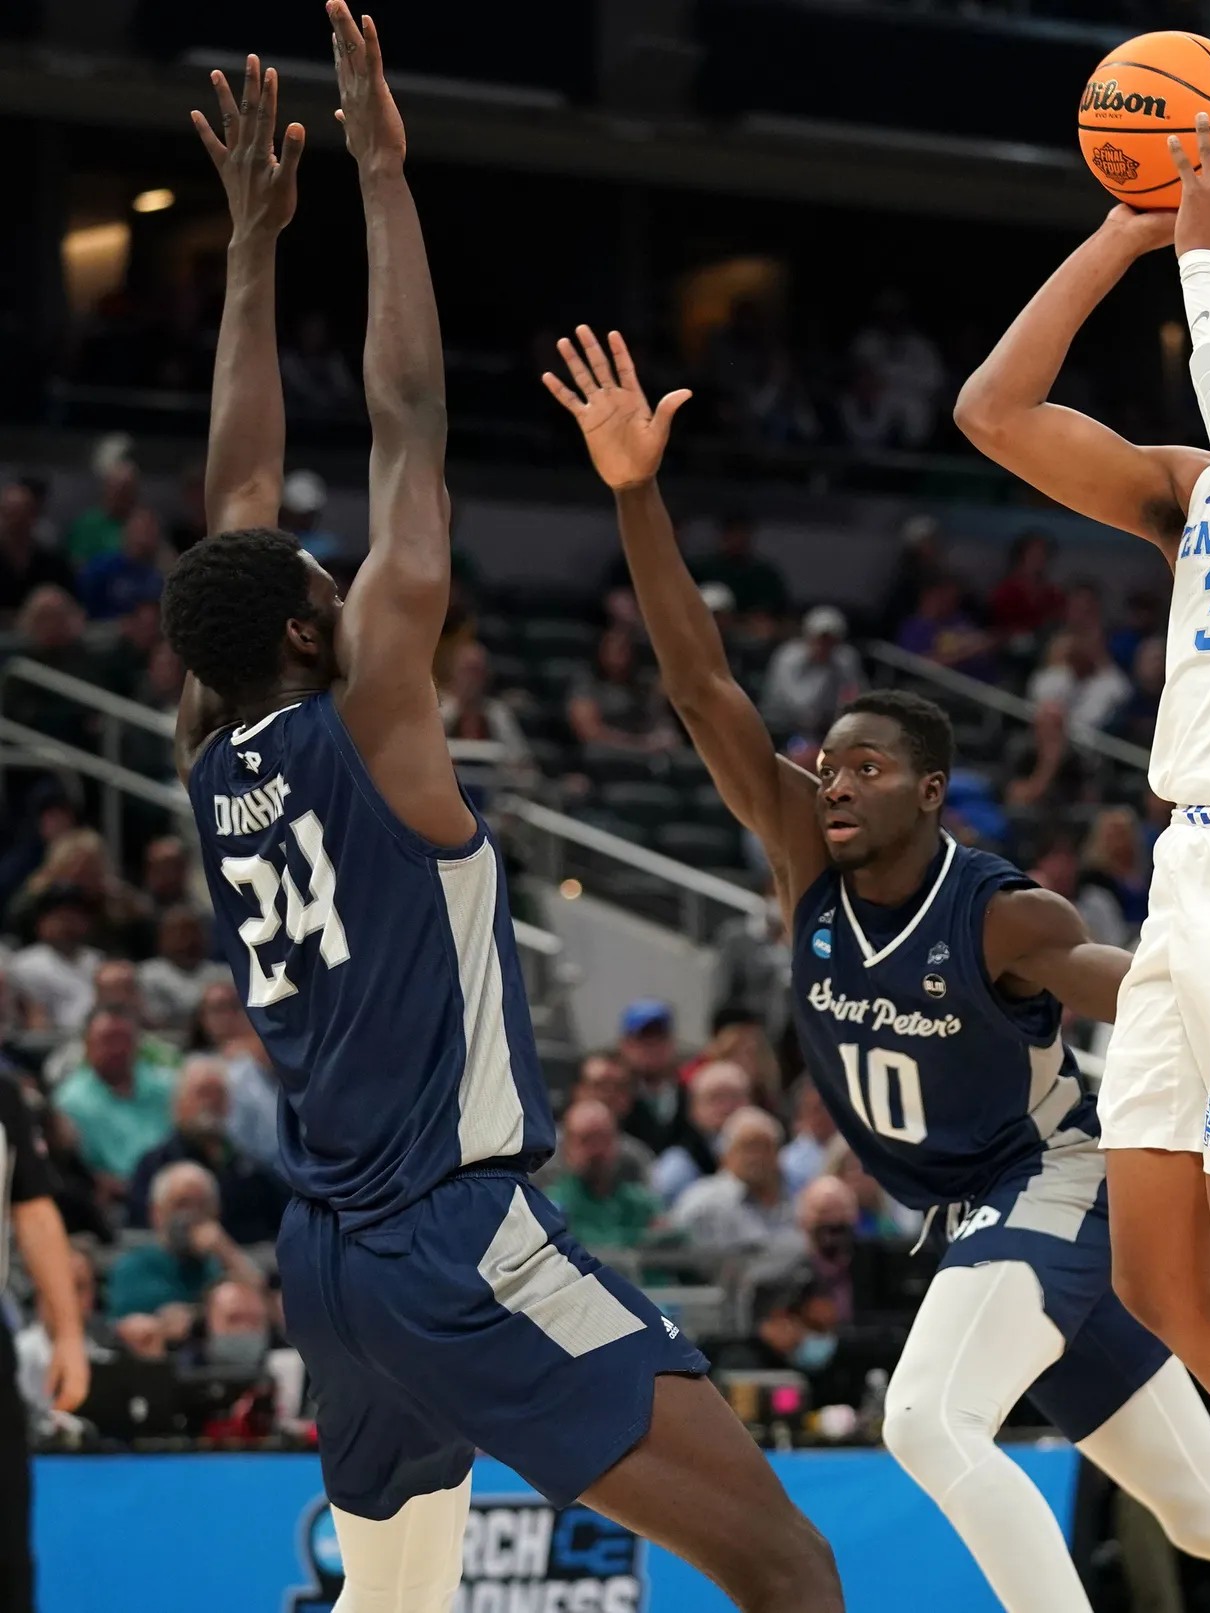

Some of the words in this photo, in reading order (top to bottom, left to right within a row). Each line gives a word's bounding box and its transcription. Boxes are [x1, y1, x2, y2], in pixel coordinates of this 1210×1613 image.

[1100, 149, 1124, 162] FINAL
[1102, 161, 1126, 176] FOUR
[220, 809, 351, 1007] 24
[838, 1043, 928, 1145] 10
[463, 1508, 555, 1577] RCH
